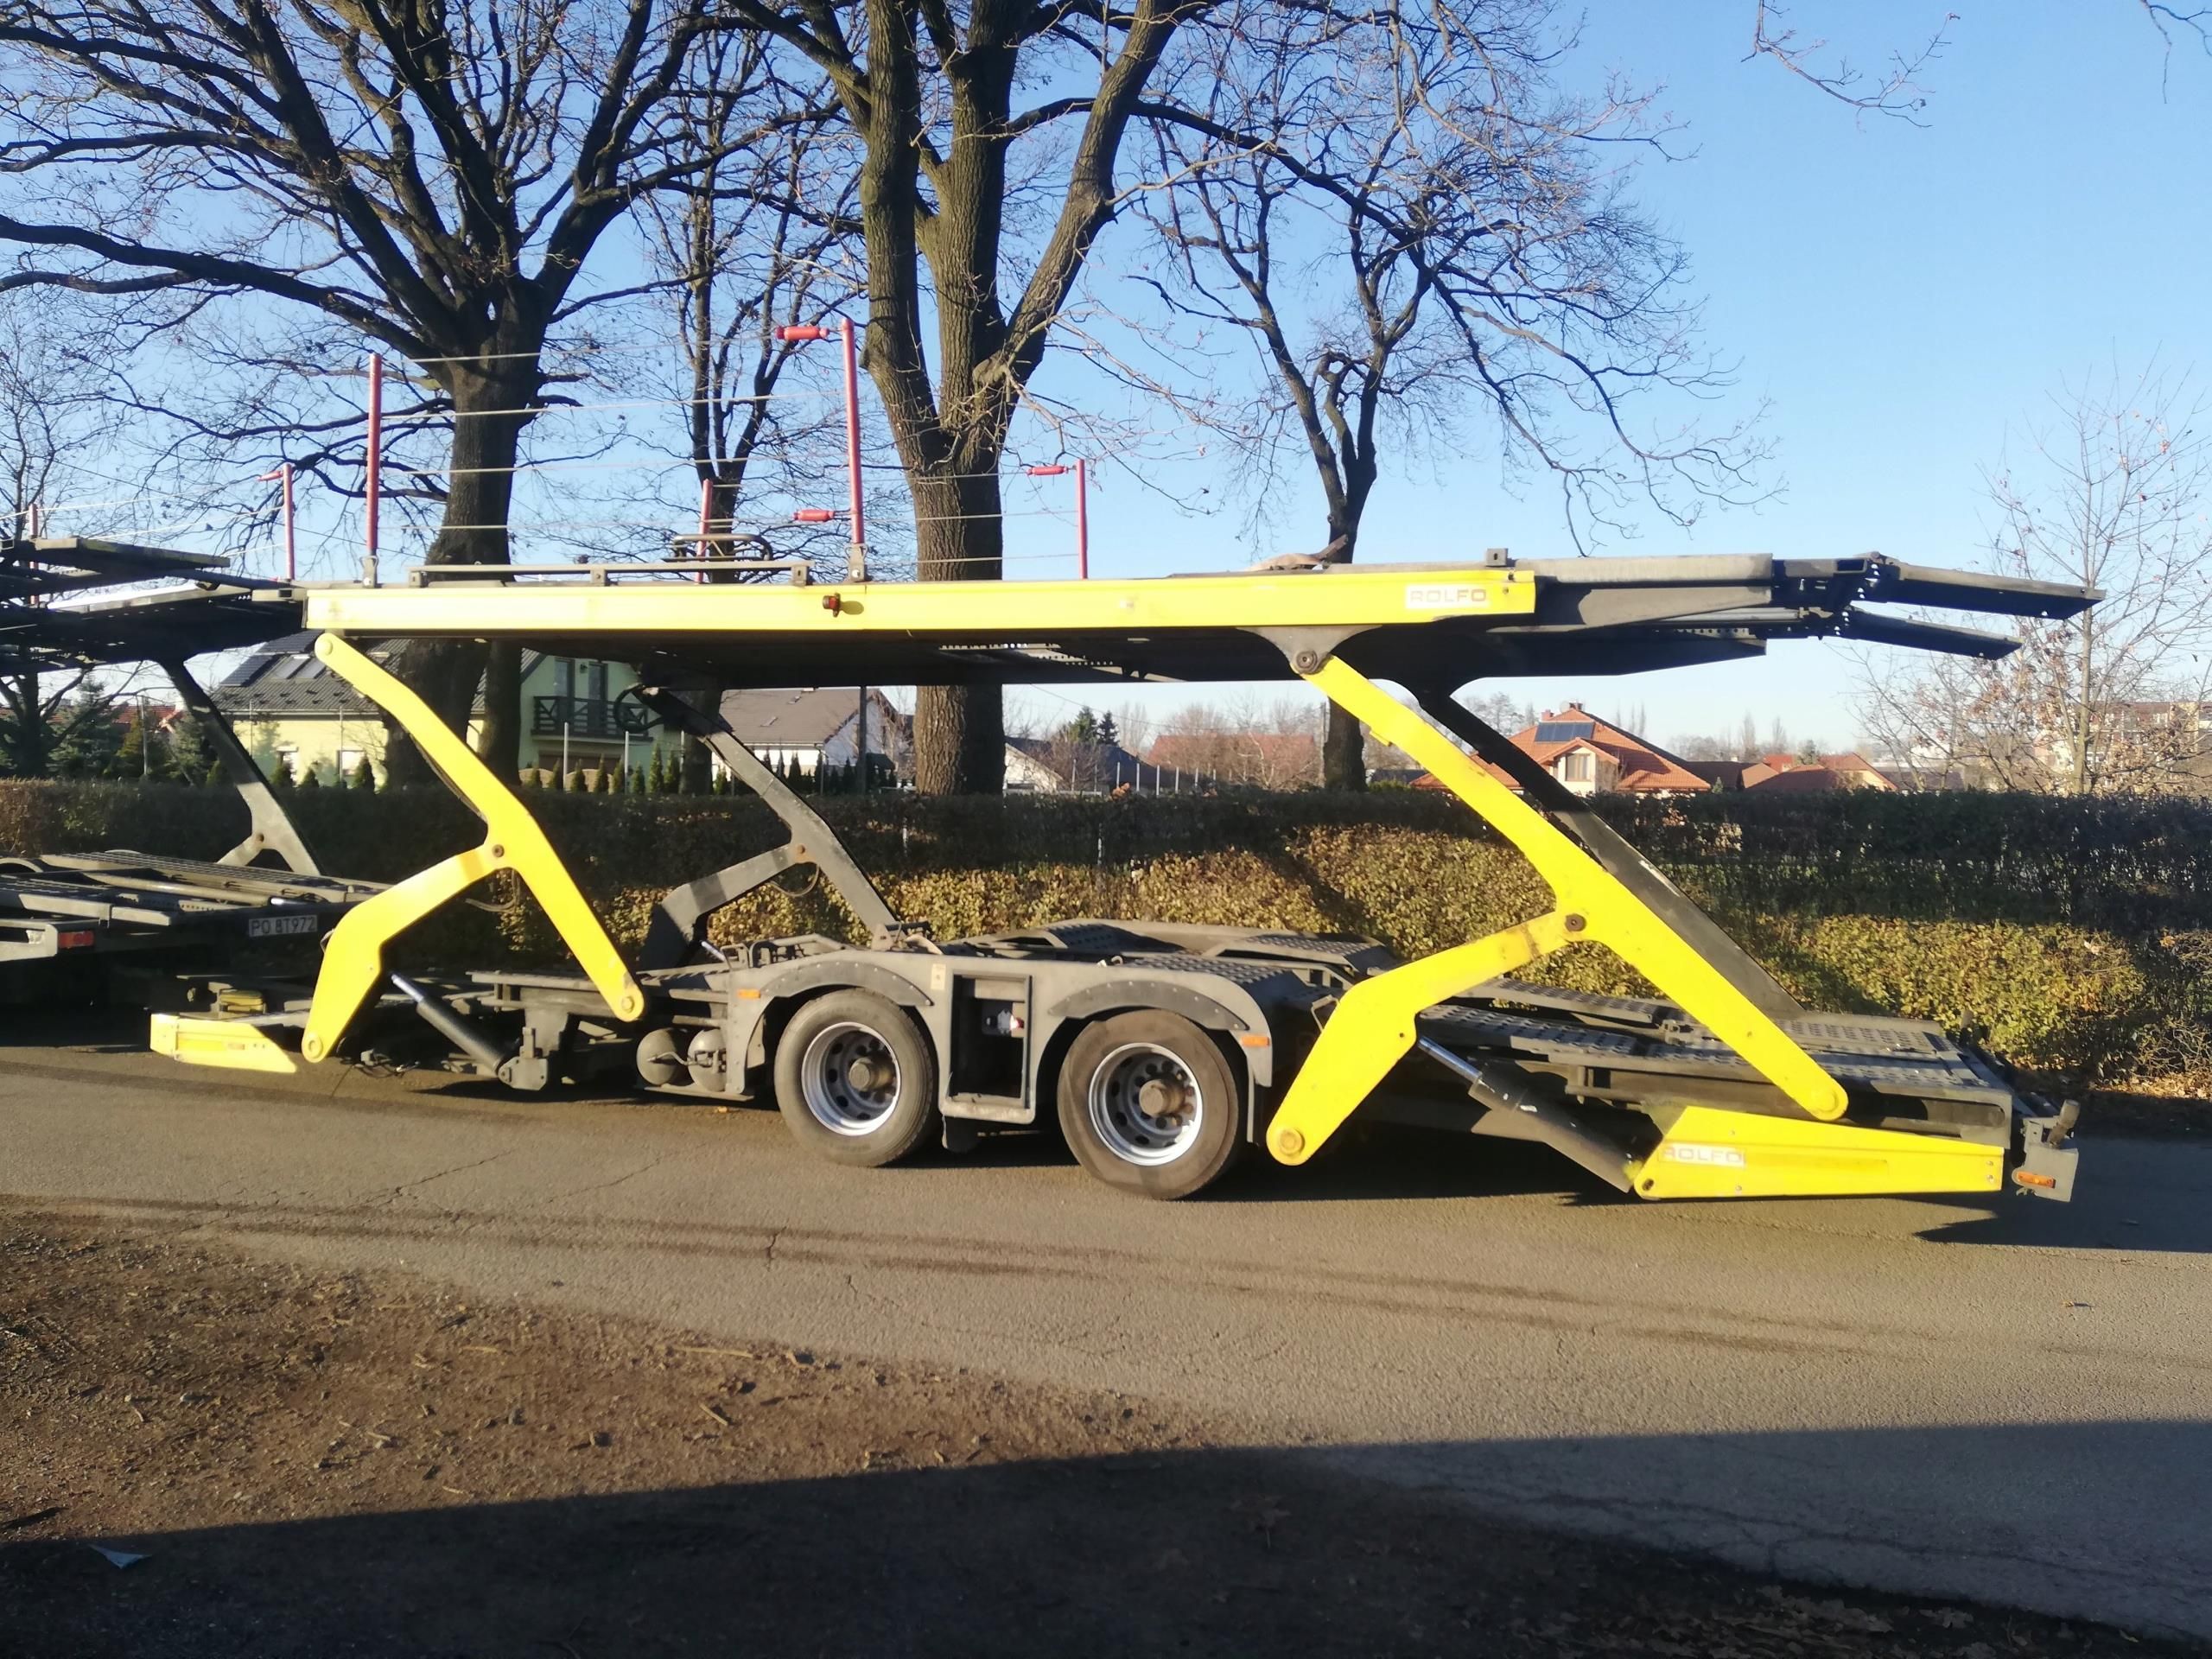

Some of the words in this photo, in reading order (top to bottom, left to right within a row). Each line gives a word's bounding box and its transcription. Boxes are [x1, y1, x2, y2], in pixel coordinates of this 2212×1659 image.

[1410, 588, 1486, 602] ROLFO
[251, 918, 270, 936] PO
[1663, 1147, 1742, 1163] ROLFO
